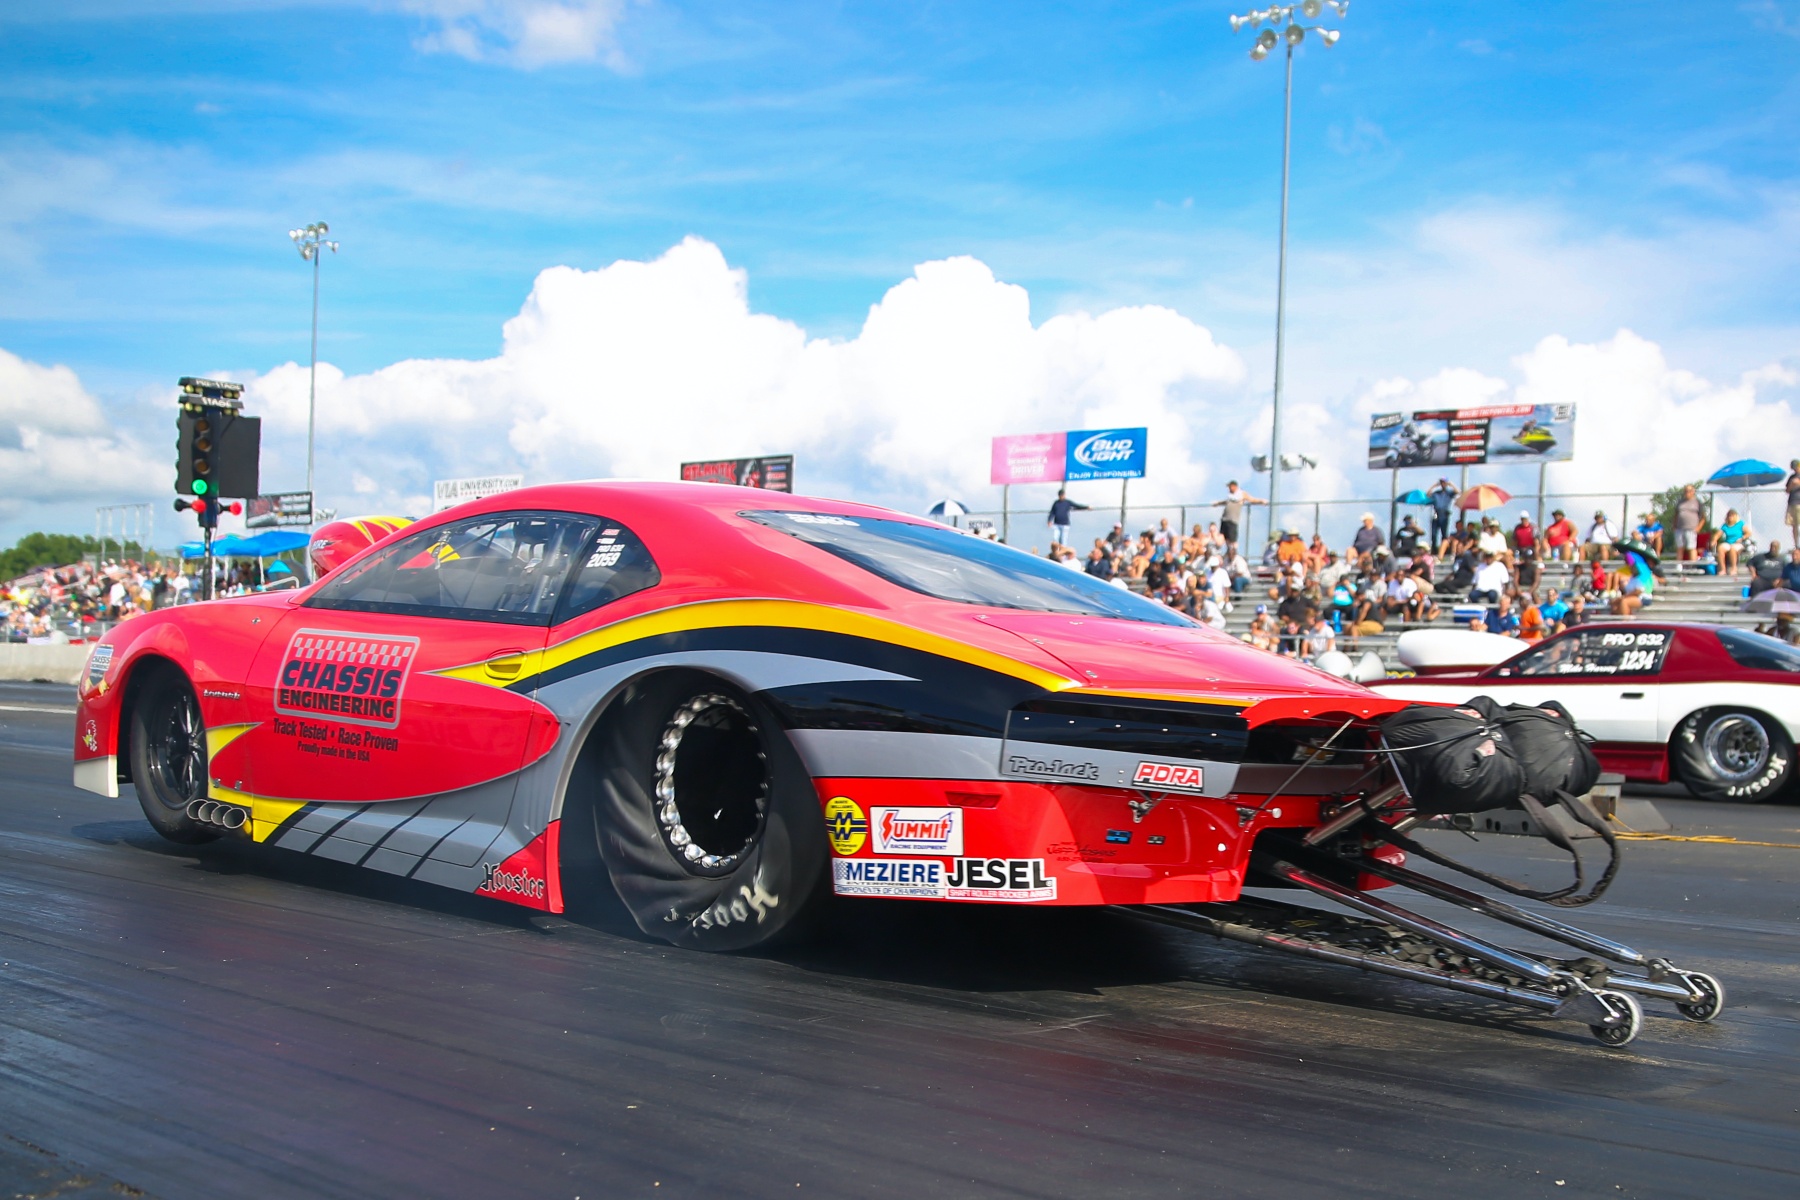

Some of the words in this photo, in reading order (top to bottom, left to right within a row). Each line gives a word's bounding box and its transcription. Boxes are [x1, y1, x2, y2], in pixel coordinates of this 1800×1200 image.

[1084, 449, 1135, 462] LIGHT
[1092, 439, 1133, 451] BUD
[1011, 464, 1045, 475] DRIVER
[586, 553, 621, 568] 2059
[1602, 633, 1635, 646] PRO
[1637, 633, 1665, 646] 632
[1619, 650, 1656, 670] 1234
[282, 660, 402, 698] CHASSIS
[280, 688, 394, 718] ENGINEERING
[274, 718, 297, 736] Track
[299, 722, 328, 741] Tested
[338, 728, 362, 747] Race
[364, 731, 398, 752] Proven
[297, 741, 320, 757] Proudly
[321, 745, 339, 757] made
[345, 748, 357, 760] the
[357, 749, 370, 762] USA
[1137, 763, 1203, 787] PDRA
[480, 862, 544, 899] Hoosier
[847, 862, 939, 883] MEZIERE
[947, 859, 1052, 889] JESEL
